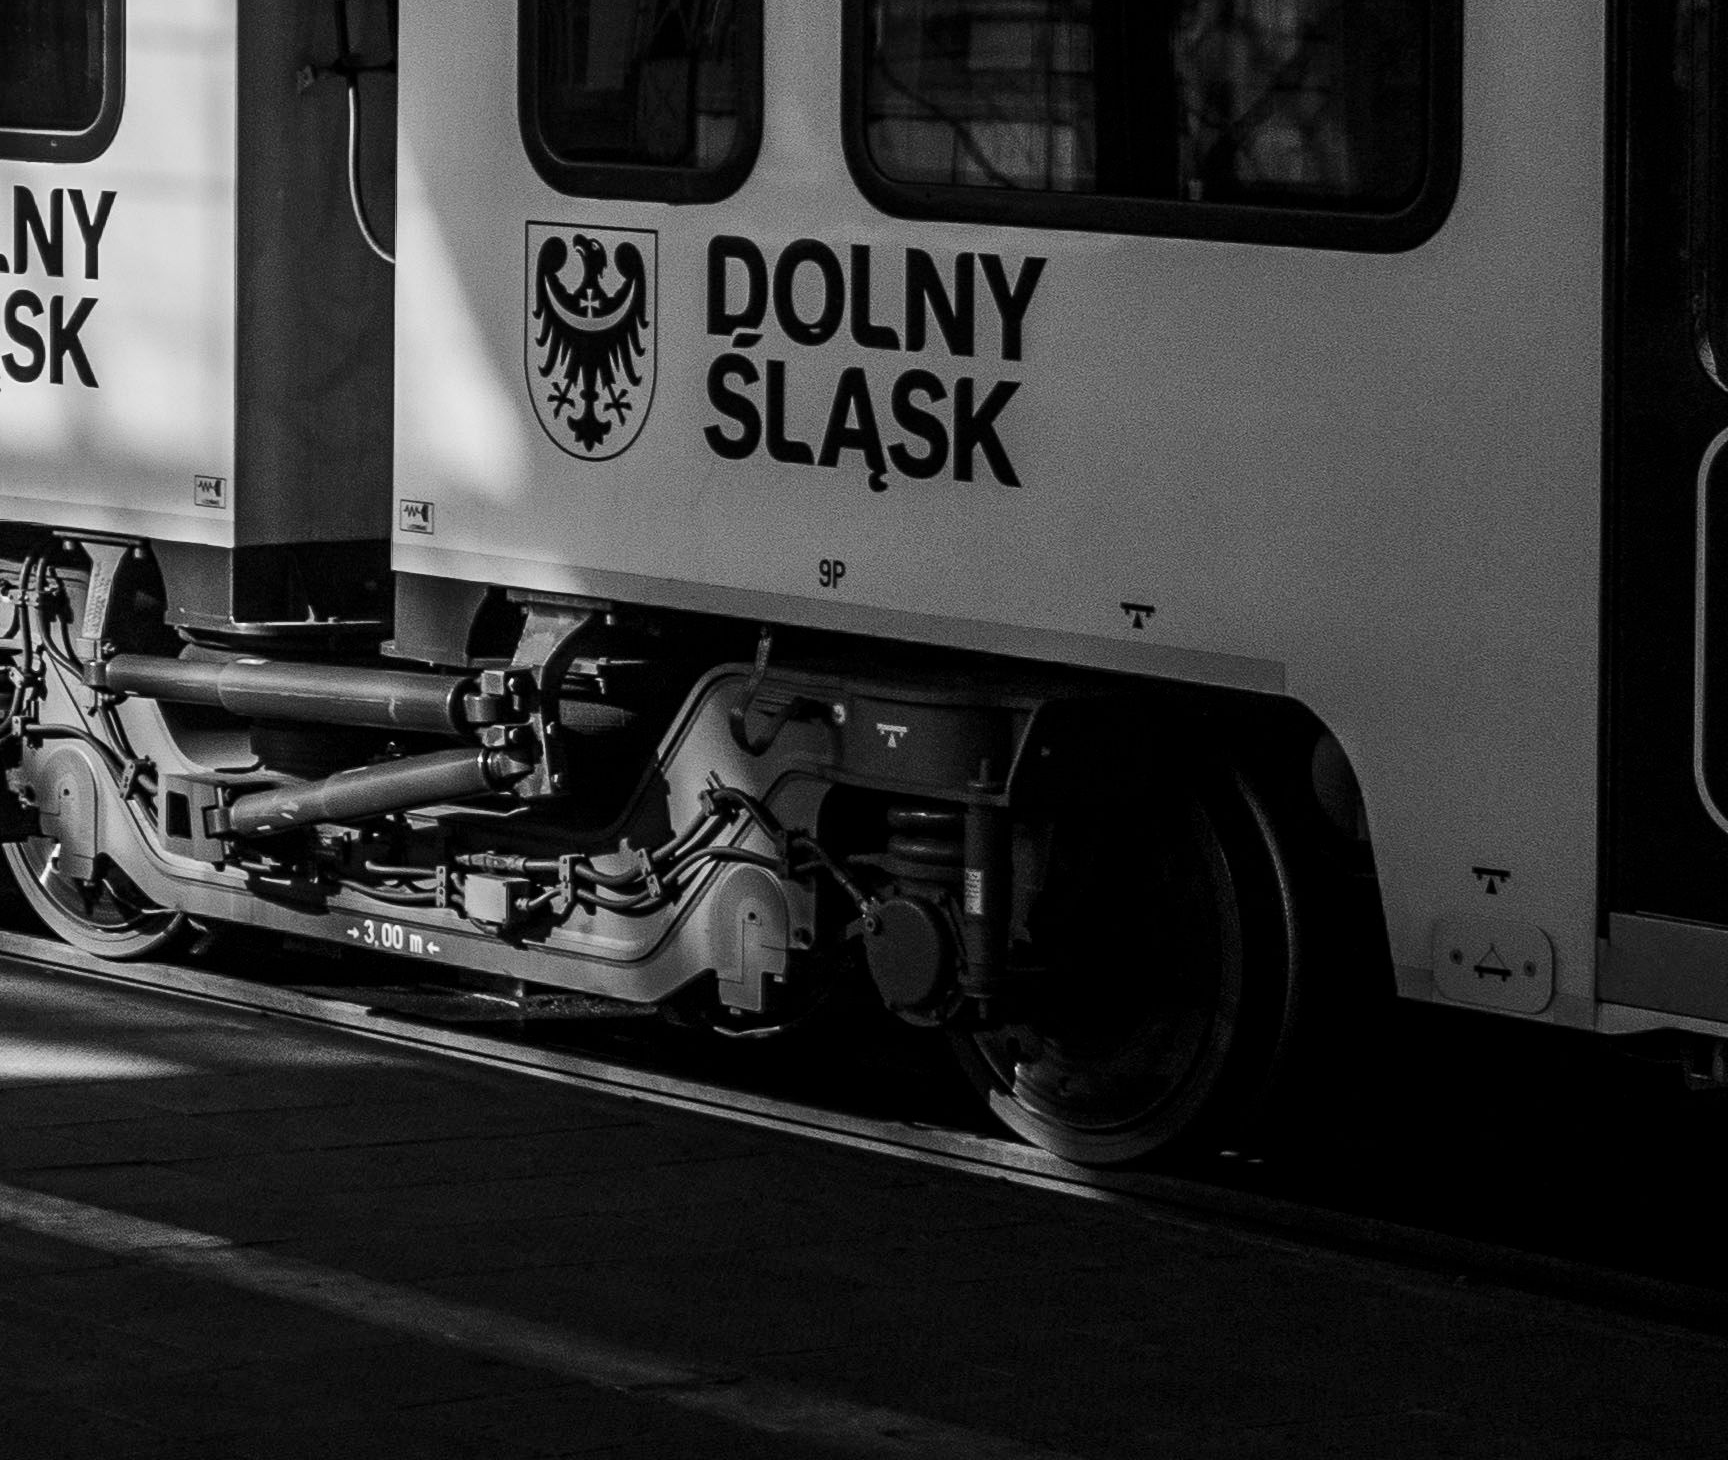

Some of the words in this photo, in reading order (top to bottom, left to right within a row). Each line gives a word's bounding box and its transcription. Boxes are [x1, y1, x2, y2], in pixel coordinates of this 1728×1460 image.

[706, 234, 1048, 362] DOLNY
[703, 332, 1023, 493] ŚLĄSK
[818, 558, 846, 589] 9P
[364, 919, 404, 950] 3,00
[409, 933, 423, 954] m
